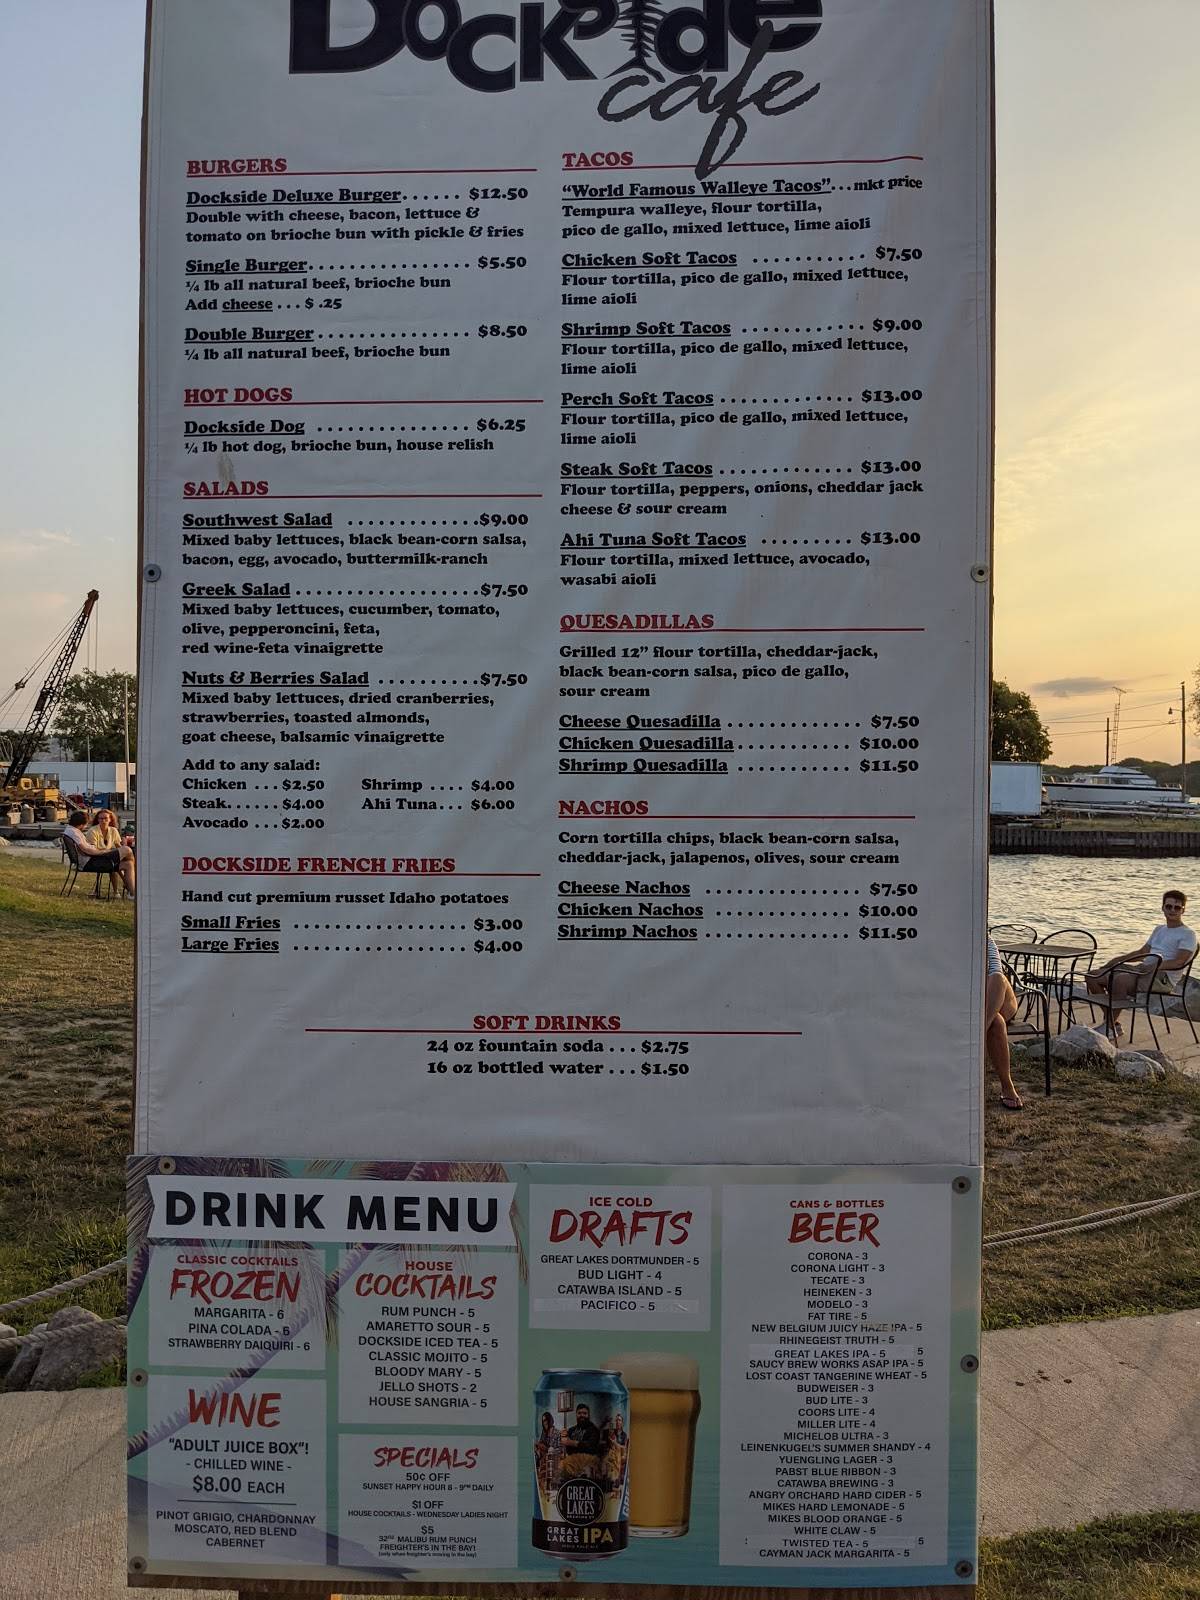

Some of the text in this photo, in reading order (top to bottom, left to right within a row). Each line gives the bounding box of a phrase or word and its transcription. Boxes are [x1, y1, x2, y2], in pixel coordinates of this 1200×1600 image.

[187, 158, 287, 174] BURGERS
[562, 152, 633, 167] TACOS
[469, 188, 528, 201] $12.50
[562, 200, 821, 219] Tempura walleye, flour tortilla,
[186, 232, 241, 242] tomato
[271, 229, 331, 240] brioche
[336, 228, 366, 239] bun
[371, 227, 409, 238] with
[415, 227, 464, 240] pickle
[469, 226, 483, 237] &
[487, 226, 523, 237] fries
[562, 217, 871, 238] pico de gallo, mixed lettuce, lime aioli
[562, 252, 736, 266] Chicken Soft Tacos
[876, 246, 922, 261] $7.50
[184, 388, 292, 403] HOT DOGS
[184, 481, 268, 496] SALADS
[182, 533, 526, 547] Mixed baby lettuces, black bean-corn salsa,
[563, 533, 746, 546] Ahi Tuna Soft Tacos
[861, 532, 920, 545] $13.00
[561, 615, 713, 630] QUESADILLAS
[560, 687, 650, 697] sour cream
[182, 711, 429, 725] strawberries, toasted almonds,
[559, 715, 720, 728] Cheese Quesadilla
[871, 715, 919, 729] $7.50
[182, 759, 319, 773] Add to any salad:
[559, 801, 648, 815] NACHOS
[183, 857, 455, 872] DOCKSIDE FRENCH FRIES
[182, 890, 508, 906] Hand cut premium russet Idaho potatoes
[181, 915, 280, 928] Small Fries
[474, 918, 523, 931] $3.00
[473, 1016, 620, 1030] SOFT DRINKS
[427, 1039, 604, 1053] 24 oz fountain soda
[641, 1040, 688, 1054] $2.75
[427, 1061, 604, 1074] 16 oz bottled water
[641, 1062, 689, 1076] $1.50
[589, 1196, 653, 1208] ICE COLD
[789, 1199, 885, 1209] CANS & BOTTLES
[166, 1191, 497, 1232] DRINK MENU
[550, 1209, 692, 1248] DRAFTS
[788, 1212, 880, 1247] BEER
[176, 1254, 299, 1267] CLASSIC COCKTAILS
[404, 1260, 454, 1272] HOUSE
[540, 1254, 575, 1264] GREAT
[576, 1255, 609, 1265] LAKES
[611, 1255, 685, 1266] DORTMUNDER
[692, 1256, 700, 1266] 5
[170, 1268, 301, 1305] FROZEN
[356, 1273, 497, 1300] COCKTAILS
[803, 1287, 857, 1297] HEINEKEN
[865, 1288, 873, 1297] 3
[194, 1307, 267, 1318] MARGARITA
[276, 1307, 285, 1319] 6
[381, 1306, 409, 1317] RUM
[412, 1306, 457, 1318] PUNCH
[467, 1307, 476, 1318] 5
[358, 1335, 422, 1347] DOCKSIDE
[425, 1336, 454, 1348] ICED
[456, 1337, 481, 1348] TEA
[491, 1338, 499, 1349] 5
[796, 1384, 859, 1393] BUDWEISER
[867, 1384, 874, 1393] 3
[187, 1389, 281, 1427] WINE
[223, 1441, 265, 1453] JUICE
[823, 1443, 870, 1453] SUMMER
[872, 1442, 916, 1452] SHANDY
[924, 1442, 931, 1451] 4
[193, 1458, 248, 1470] CHILLED
[250, 1460, 284, 1471] WINE
[374, 1447, 479, 1469] SPECIALS
[428, 1472, 451, 1482] OFF
[775, 1467, 809, 1476] PABST
[811, 1467, 839, 1477] BLUE
[840, 1467, 881, 1477] RIBBON
[889, 1467, 897, 1476] 3
[192, 1475, 285, 1494] $8.00 EACH
[567, 1486, 596, 1500] GREAT
[567, 1501, 595, 1515] LAKES
[547, 1527, 580, 1535] GREAT
[583, 1528, 614, 1543] IPA
[205, 1537, 265, 1549] CABERNET
[547, 1535, 580, 1543] LAKES
[759, 1548, 804, 1558] CAYMAN
[805, 1549, 832, 1559] JACK
[834, 1549, 895, 1559] MARGARITA
[903, 1548, 910, 1558] 5
